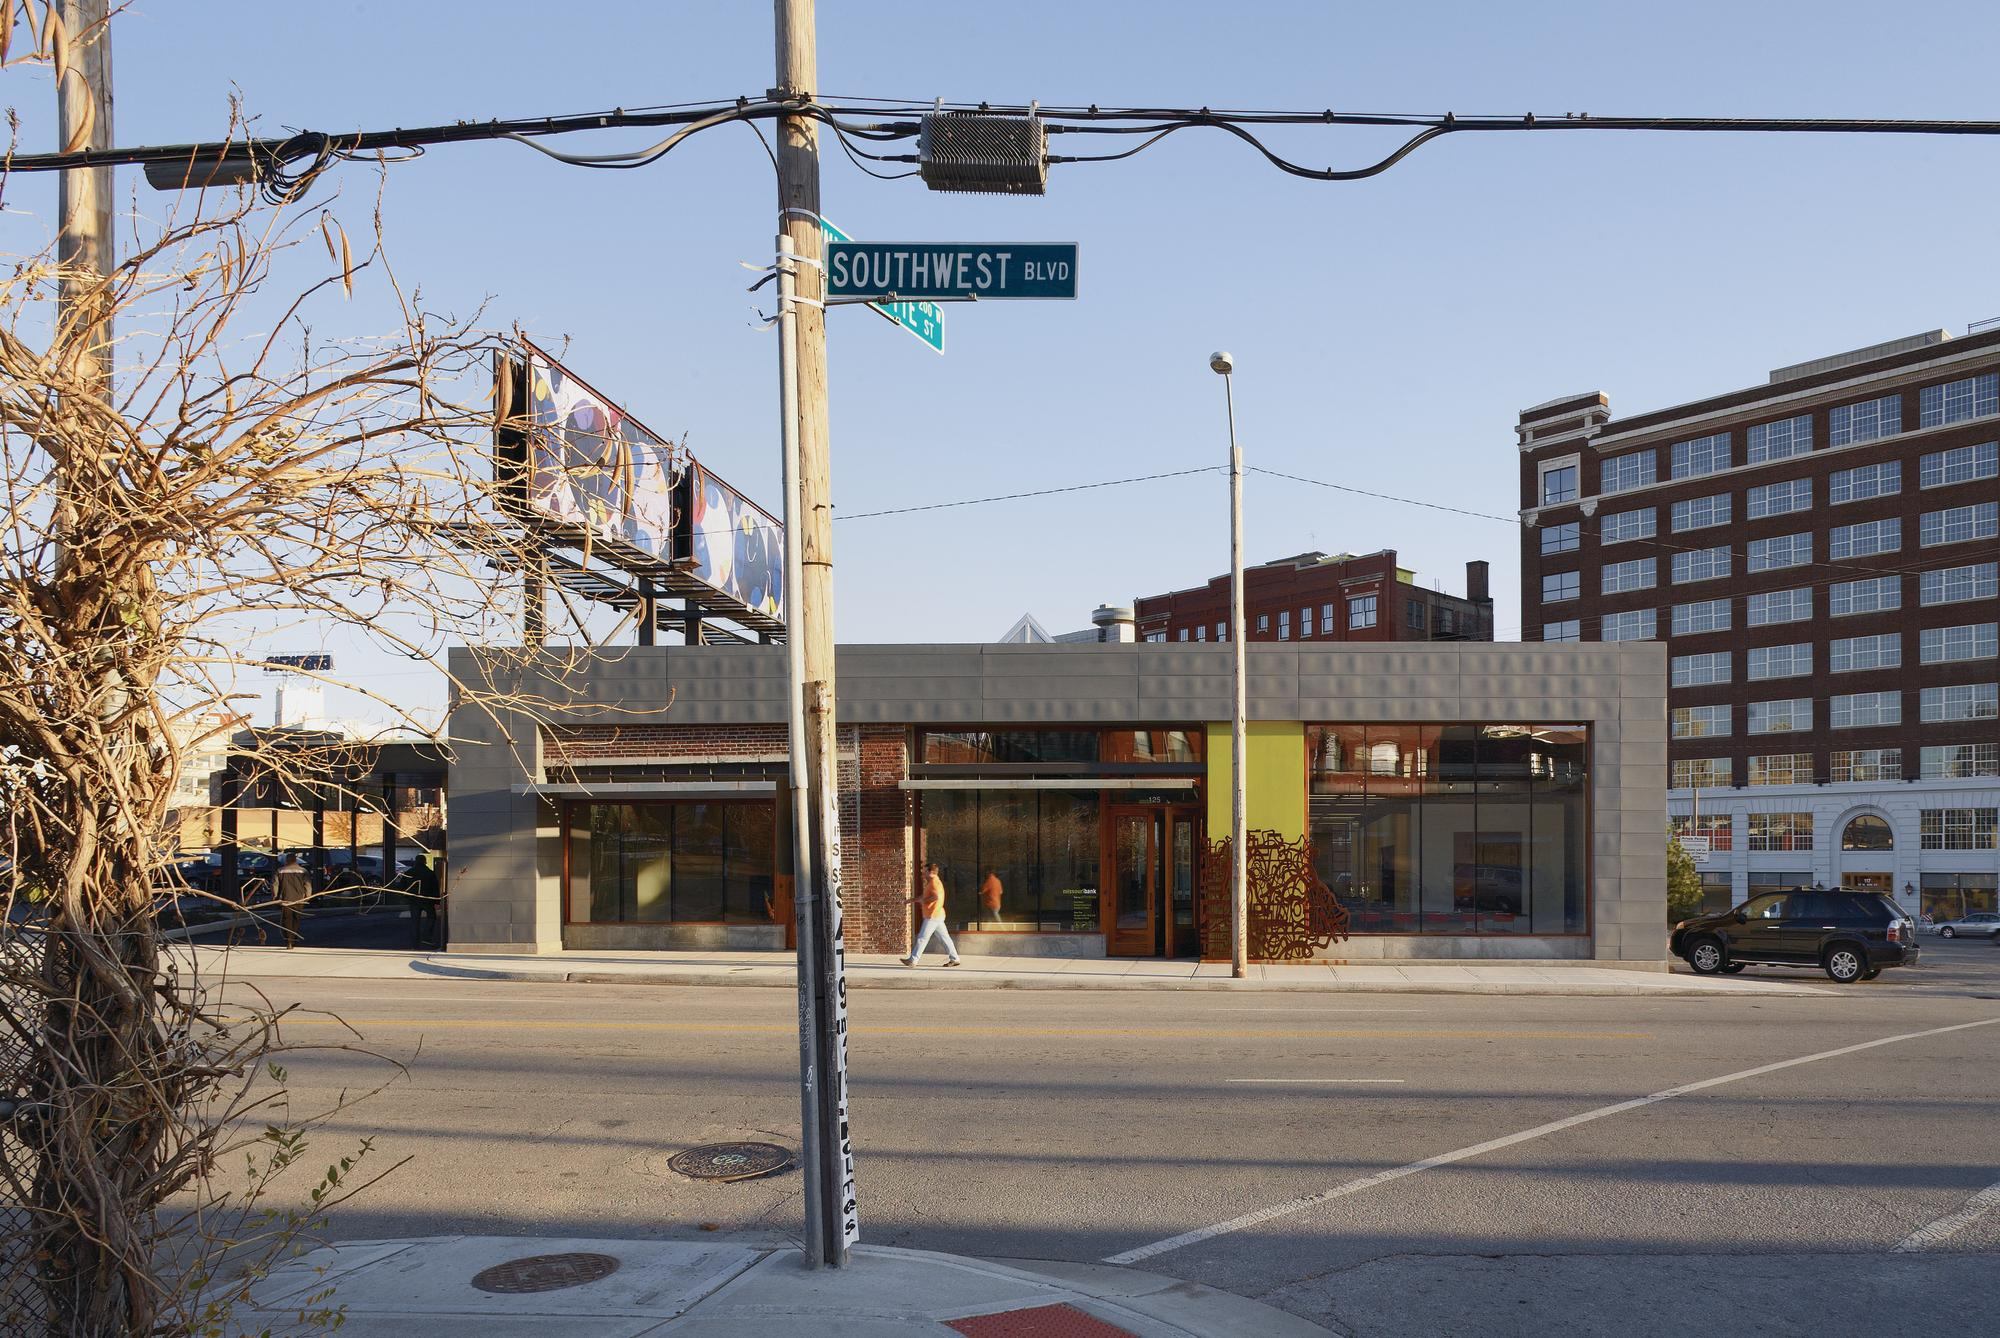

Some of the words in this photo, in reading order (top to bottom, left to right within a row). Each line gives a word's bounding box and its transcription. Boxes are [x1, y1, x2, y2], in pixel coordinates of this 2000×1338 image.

[833, 251, 1011, 289] SOUTHWEST
[1024, 262, 1069, 281] BLVD
[924, 319, 935, 339] ST
